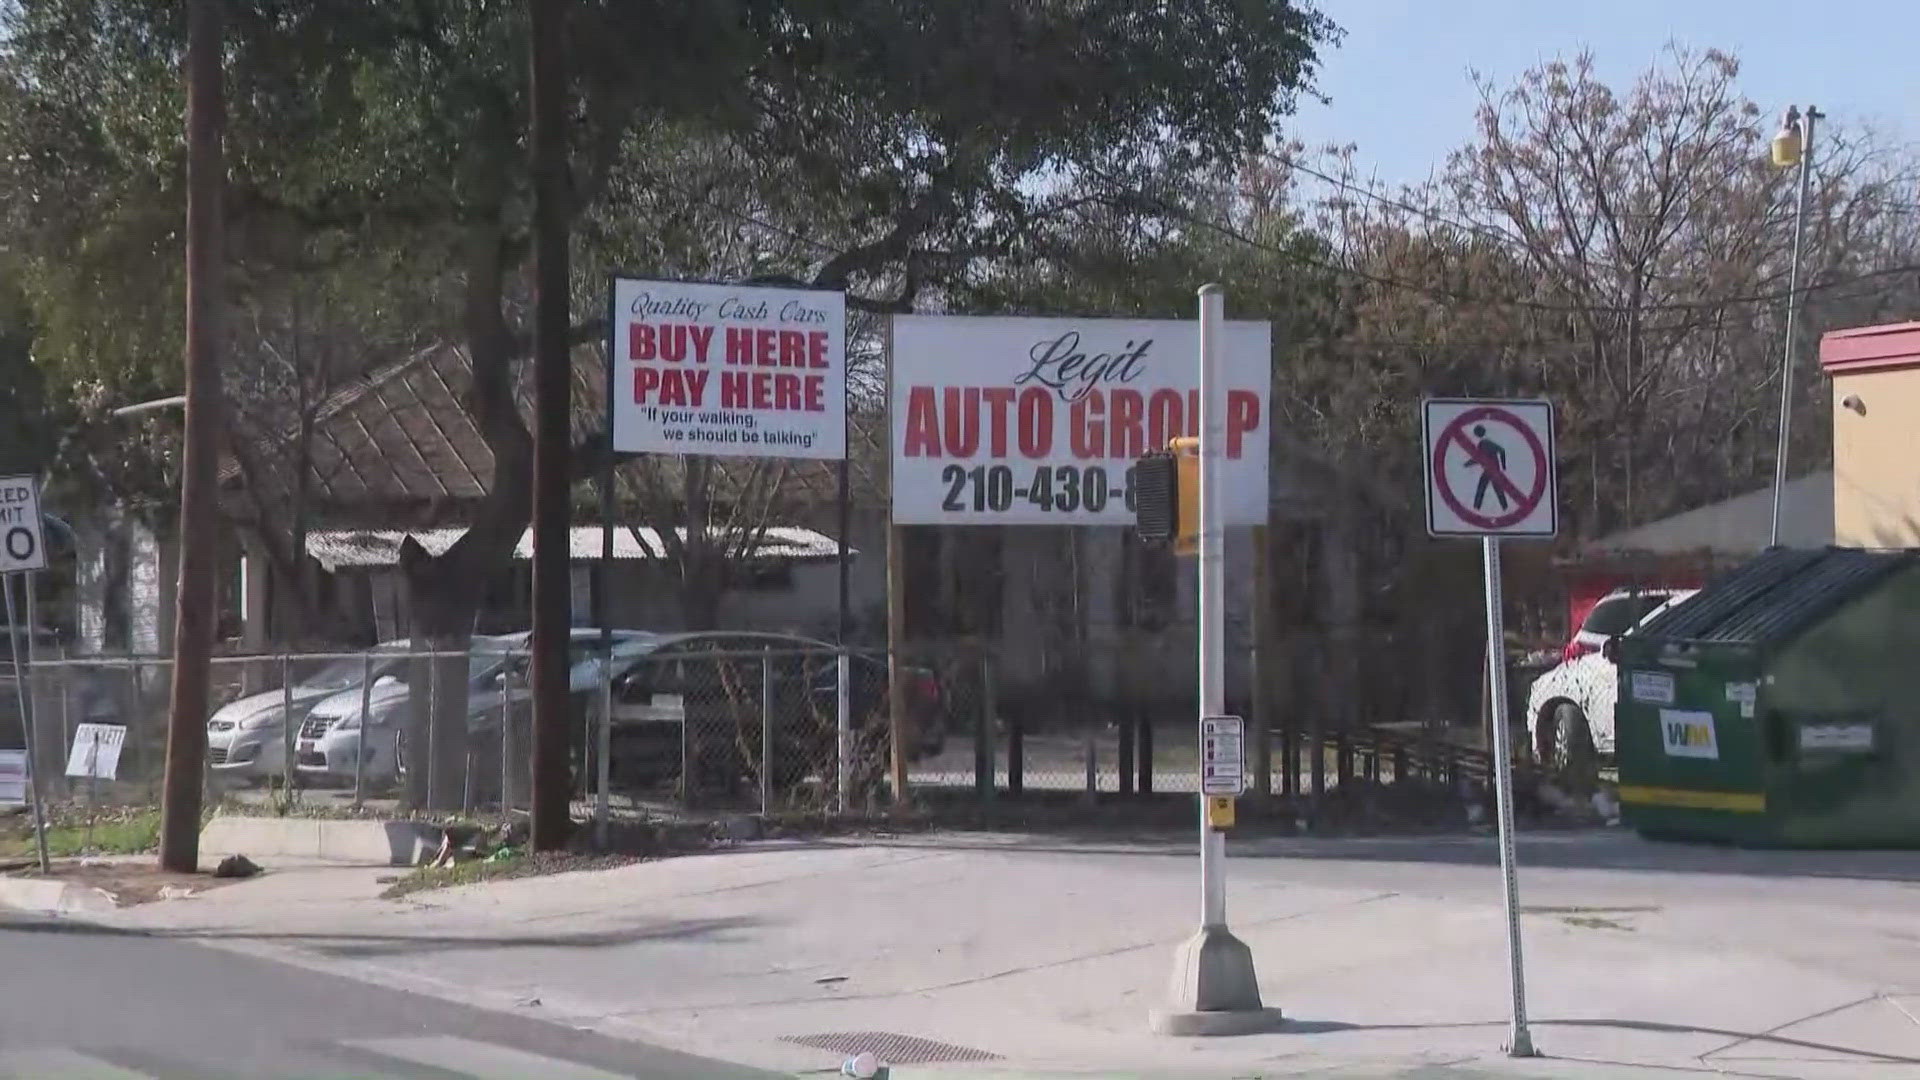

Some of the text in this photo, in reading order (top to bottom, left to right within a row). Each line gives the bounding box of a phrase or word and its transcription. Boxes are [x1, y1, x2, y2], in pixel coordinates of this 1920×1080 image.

[631, 292, 827, 322] Quality Cash Cars
[630, 323, 829, 368] BUY HERE
[1014, 331, 1153, 401] Legit
[634, 367, 825, 411] PAY HERE
[662, 411, 694, 425] your
[699, 412, 758, 428] walking,
[663, 430, 684, 441] we
[689, 428, 737, 442] should
[742, 430, 759, 443] be
[904, 385, 1053, 459] AUTO
